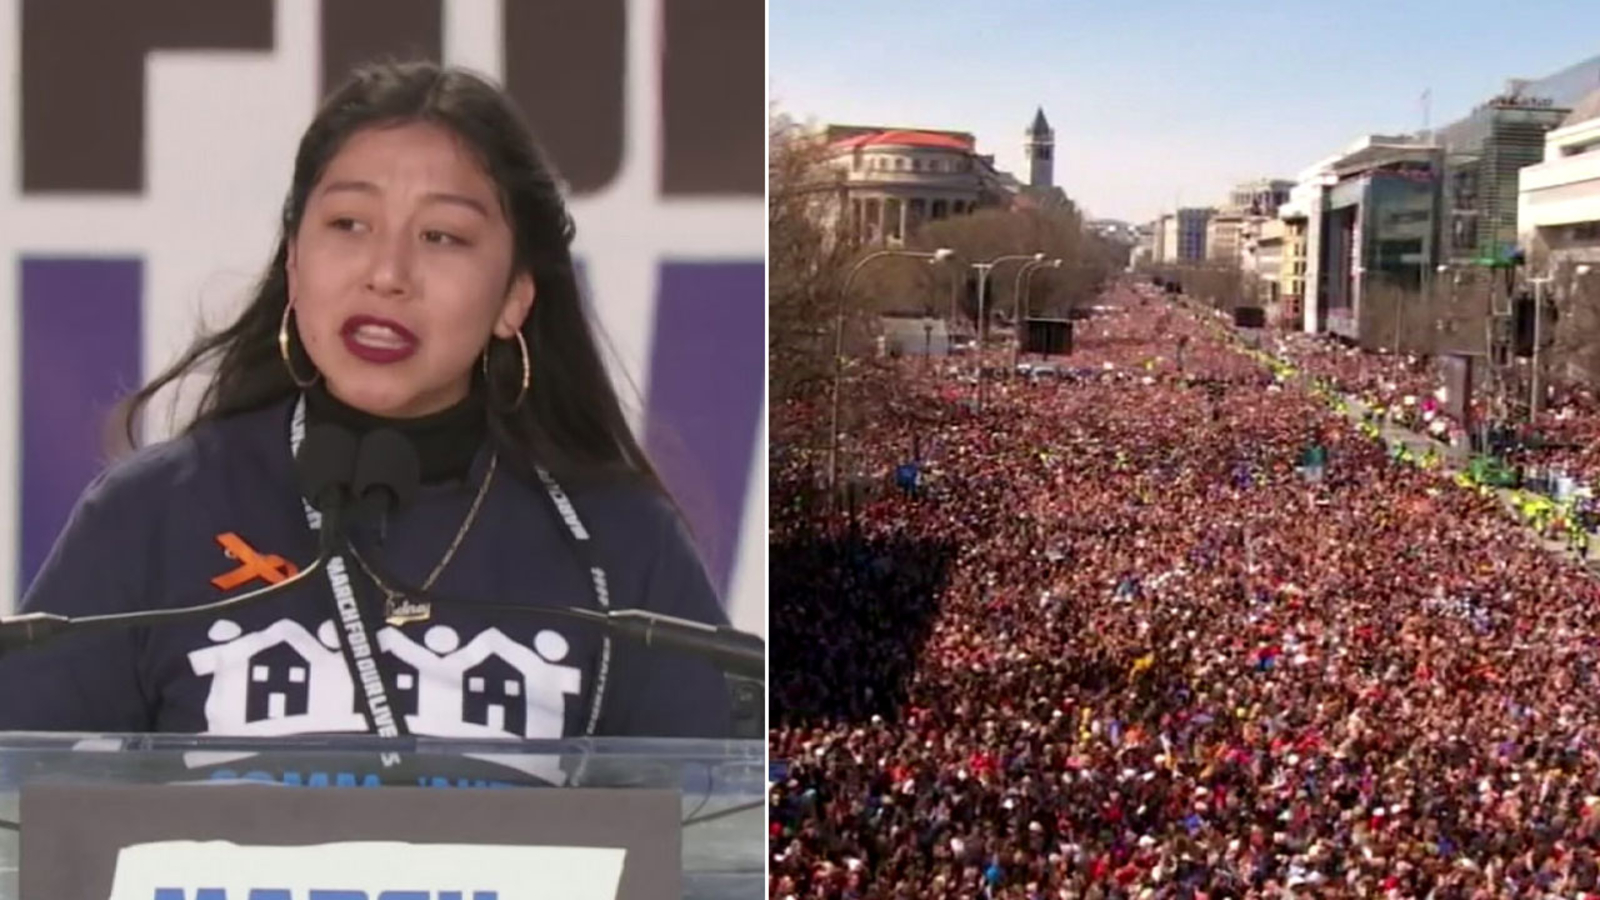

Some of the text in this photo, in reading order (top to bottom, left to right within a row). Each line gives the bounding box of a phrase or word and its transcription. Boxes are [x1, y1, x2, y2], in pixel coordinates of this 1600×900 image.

[326, 555, 361, 630] MARCH
[344, 620, 372, 660] FOR
[355, 656, 385, 698] OUR
